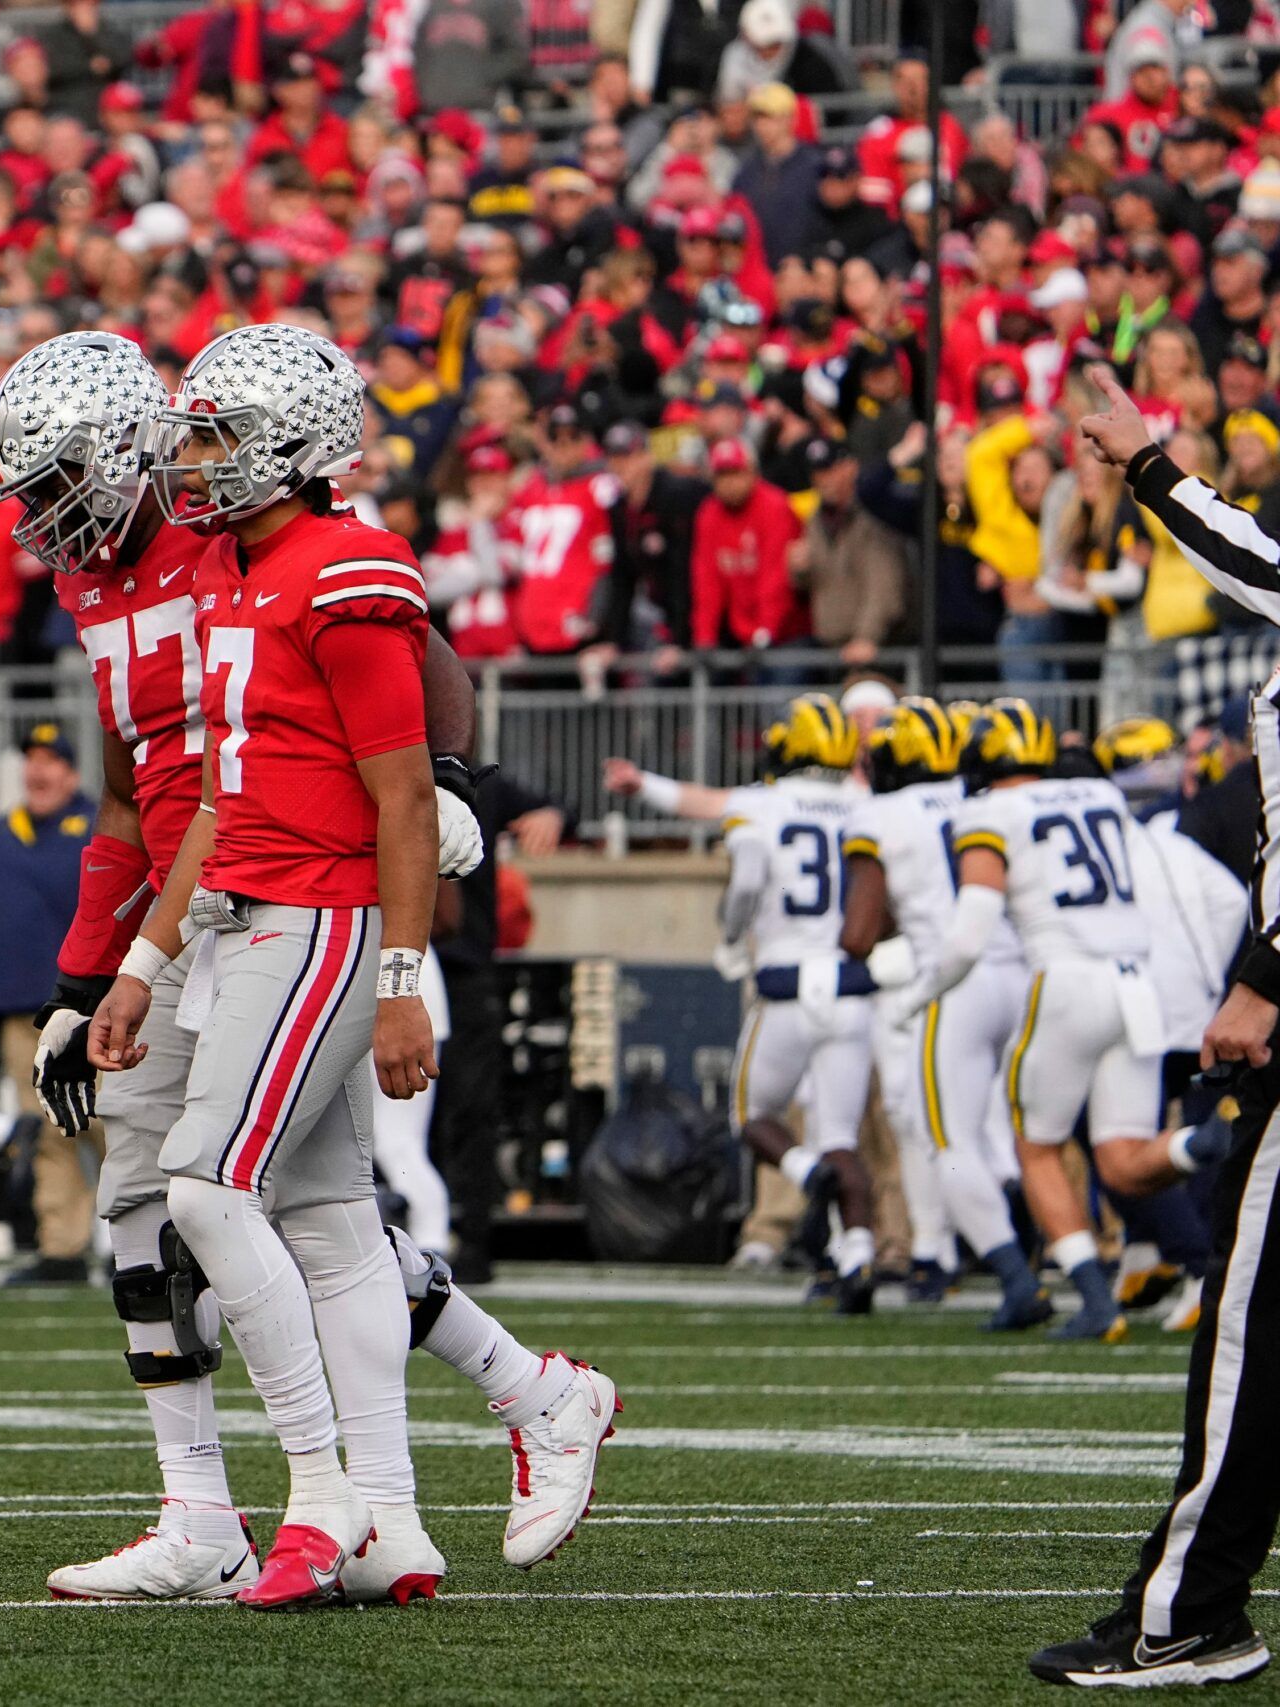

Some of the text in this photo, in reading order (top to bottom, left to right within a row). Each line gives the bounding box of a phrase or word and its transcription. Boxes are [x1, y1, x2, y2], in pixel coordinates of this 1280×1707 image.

[81, 594, 206, 765] 77
[205, 626, 255, 794] 7
[1032, 808, 1135, 907] 30
